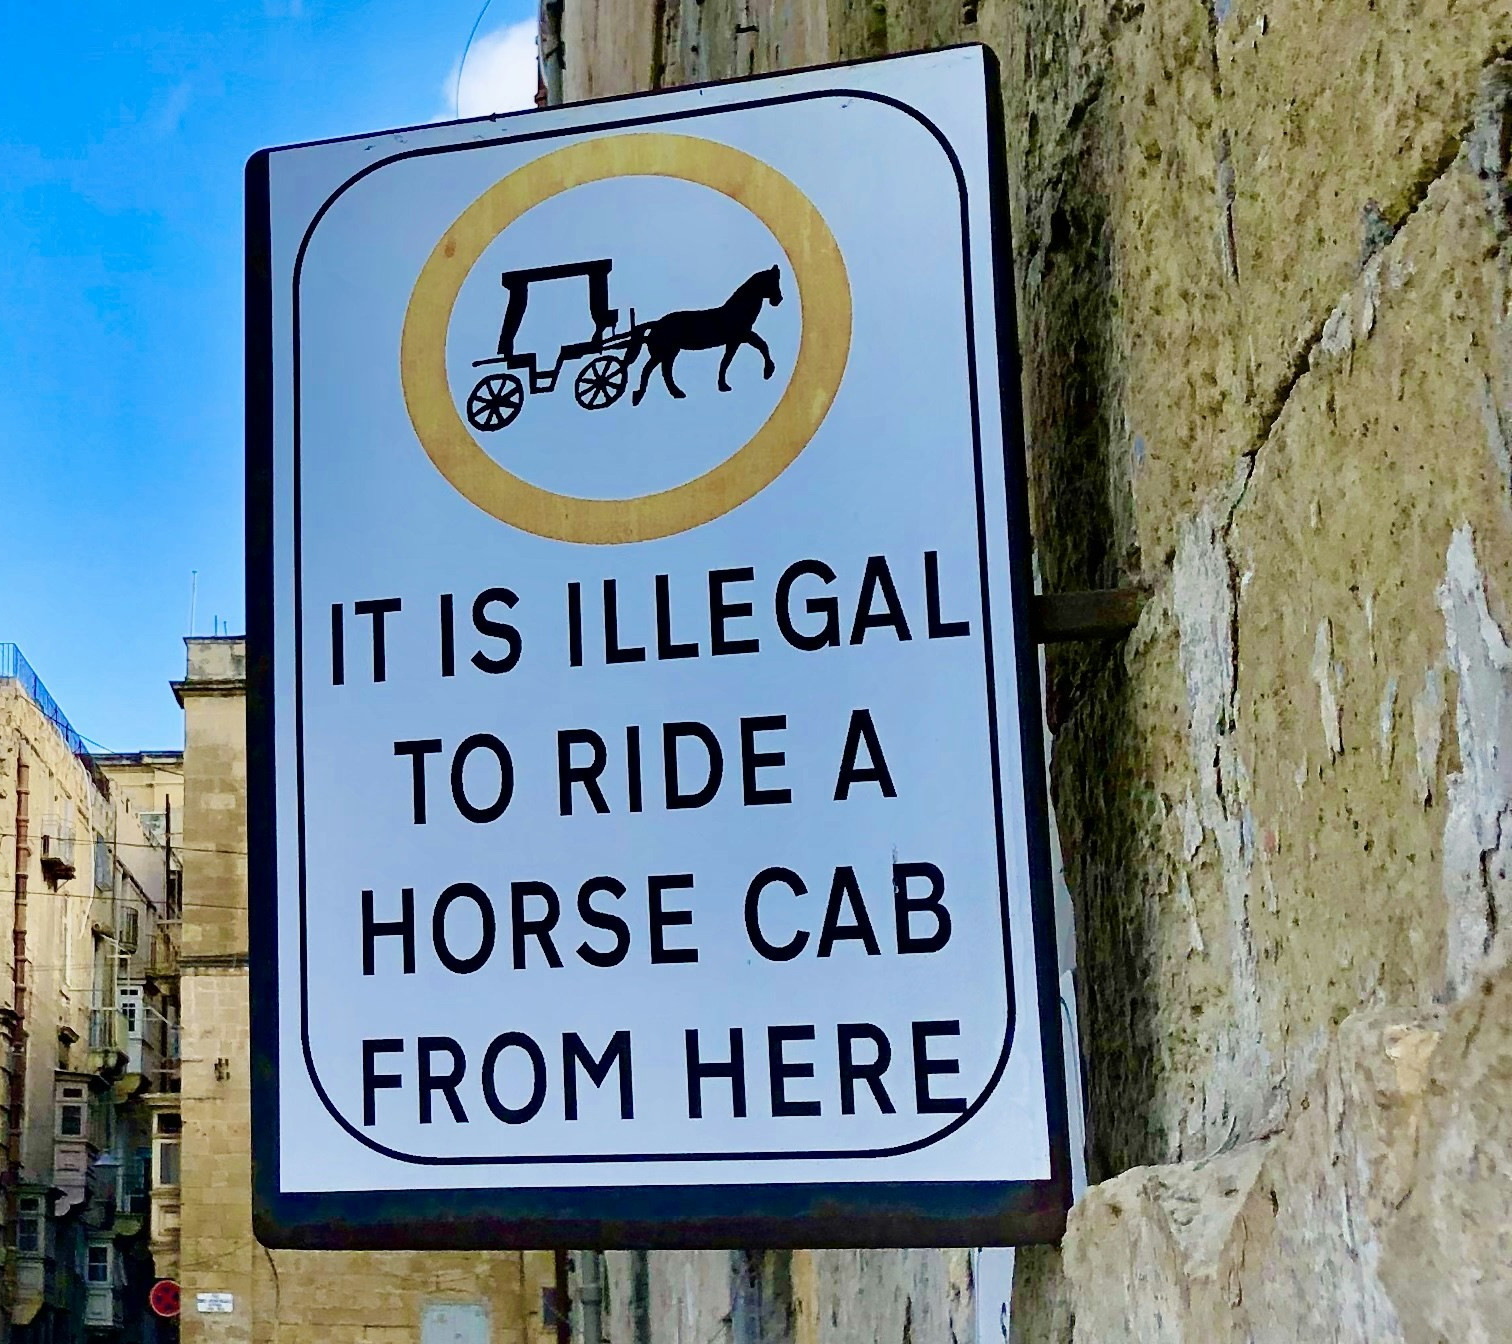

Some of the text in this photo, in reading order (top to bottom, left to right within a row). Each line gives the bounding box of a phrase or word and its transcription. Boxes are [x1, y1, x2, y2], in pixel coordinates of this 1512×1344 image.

[331, 550, 971, 686] IT IS ILLEGAL
[393, 708, 898, 825] TO RIDE A
[361, 861, 952, 976] HORSE CAB
[362, 1019, 968, 1127] FROM HERE
